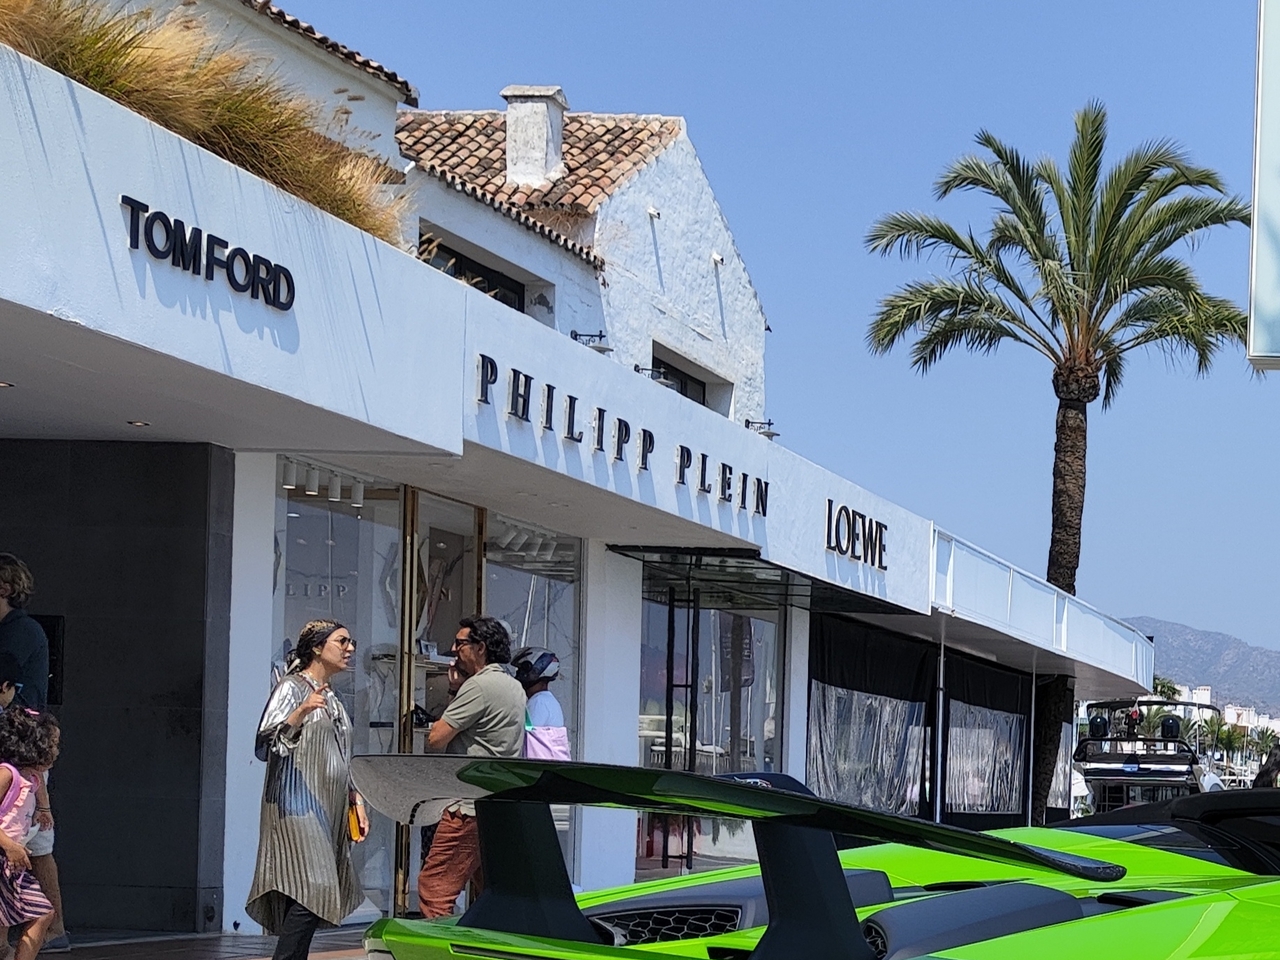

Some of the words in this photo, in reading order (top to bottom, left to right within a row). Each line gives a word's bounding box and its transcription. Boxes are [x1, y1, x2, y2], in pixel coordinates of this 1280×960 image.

[120, 194, 202, 276] TOM
[205, 233, 296, 312] FORD
[476, 353, 655, 472] PHILIPP
[676, 444, 770, 518] PLEIN
[825, 497, 888, 572] LOEWE
